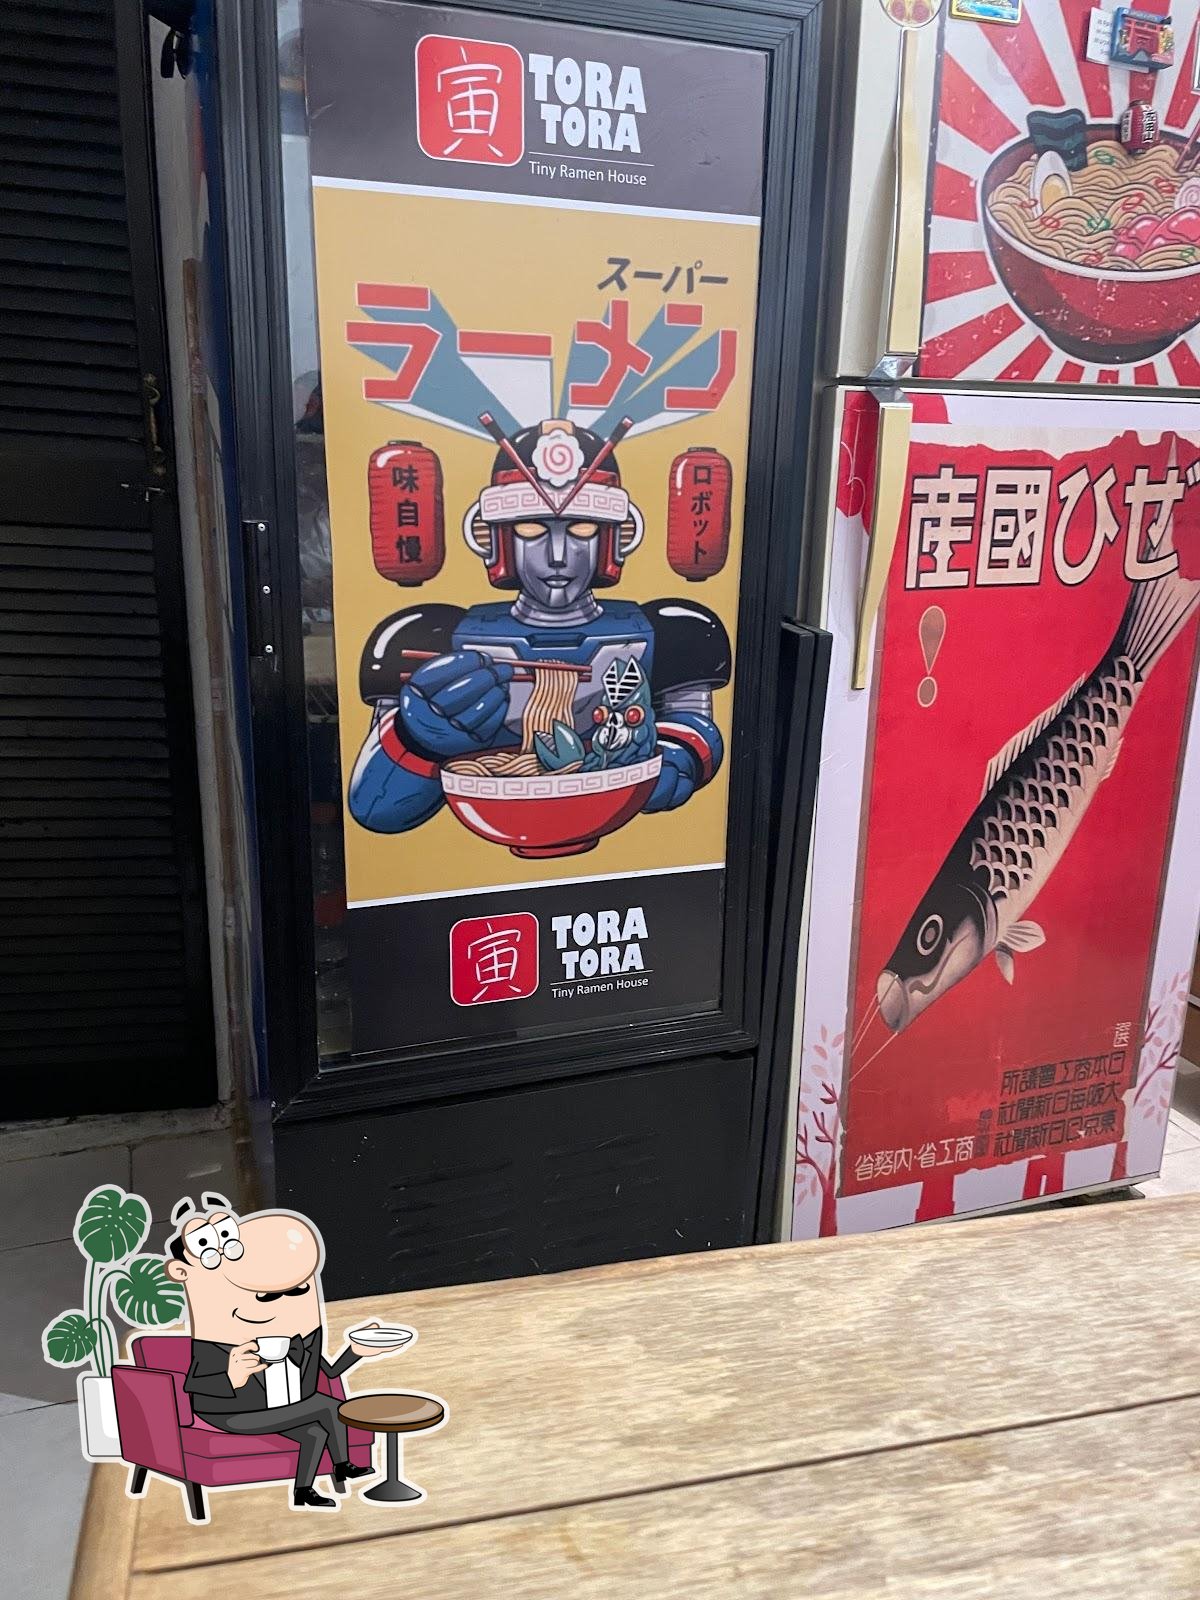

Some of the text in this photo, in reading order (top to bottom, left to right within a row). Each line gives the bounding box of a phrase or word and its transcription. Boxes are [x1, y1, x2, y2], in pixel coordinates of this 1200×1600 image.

[528, 53, 647, 114] TORA
[540, 104, 641, 153] TORA
[528, 160, 647, 186] Tiny Ramen House
[597, 257, 729, 294] スーパー
[346, 281, 738, 412] ラーメン
[691, 465, 713, 565] ロボット
[551, 906, 649, 949] TORA
[561, 943, 645, 980] TORA
[551, 977, 649, 999] Tiny Ramen House
